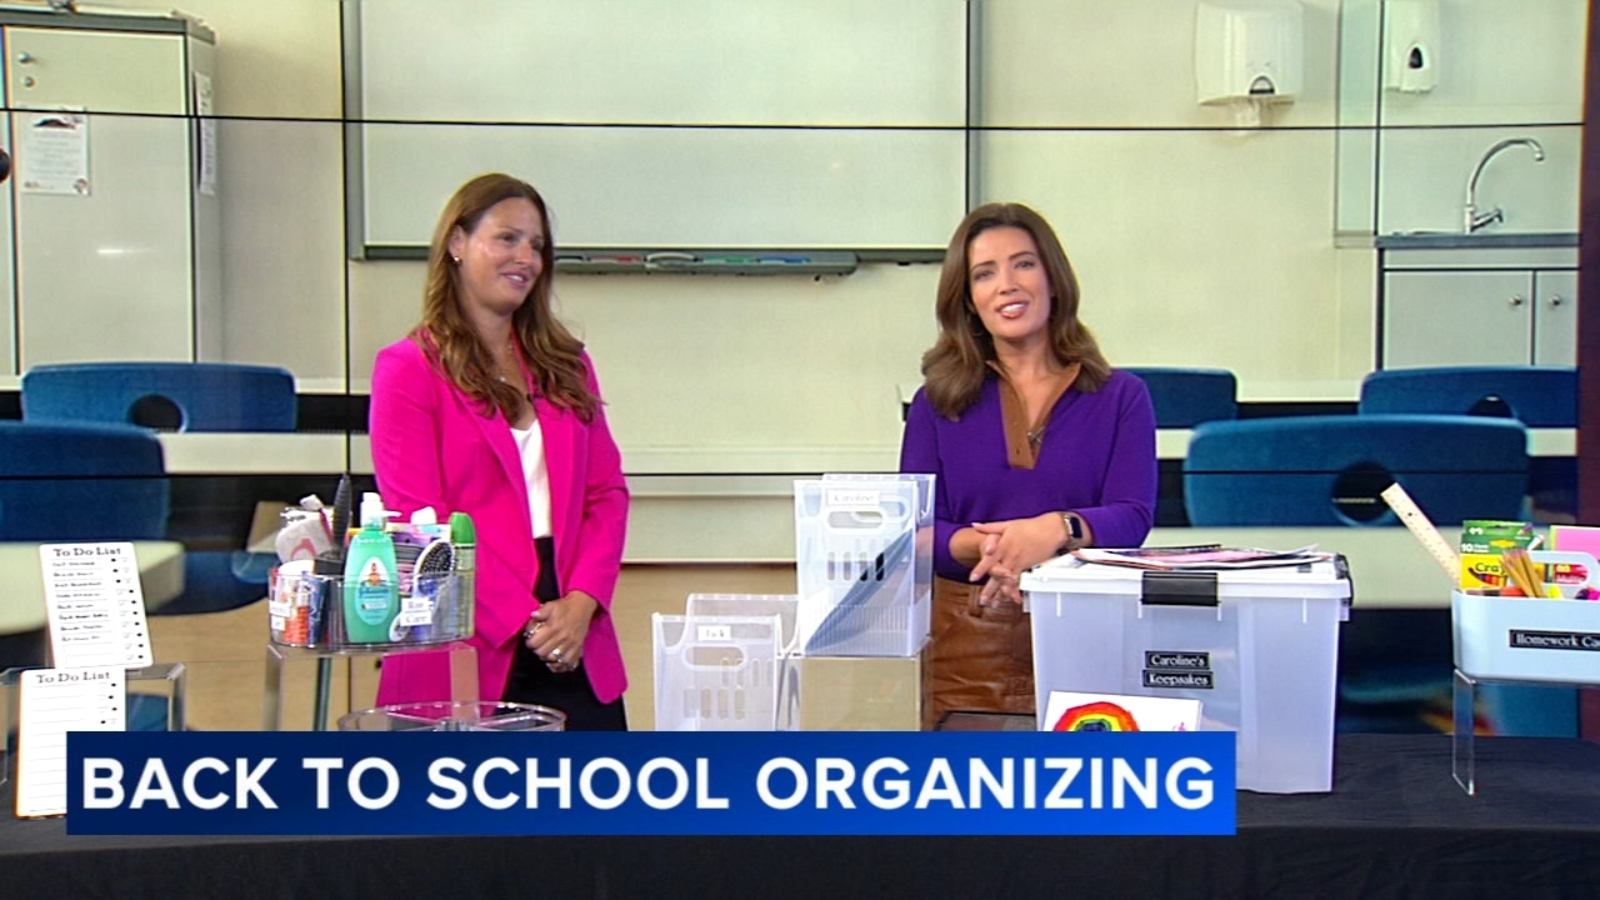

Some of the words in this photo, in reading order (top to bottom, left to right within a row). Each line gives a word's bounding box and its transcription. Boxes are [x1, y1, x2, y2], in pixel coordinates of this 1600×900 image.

[53, 547, 71, 557] To
[73, 547, 94, 556] Do
[96, 546, 121, 556] List
[1516, 633, 1578, 647] Homework
[1150, 654, 1206, 667] Caroline's
[35, 673, 55, 684] To
[57, 672, 80, 682] Do
[82, 671, 110, 681] List
[1148, 672, 1209, 686] Keepsakes
